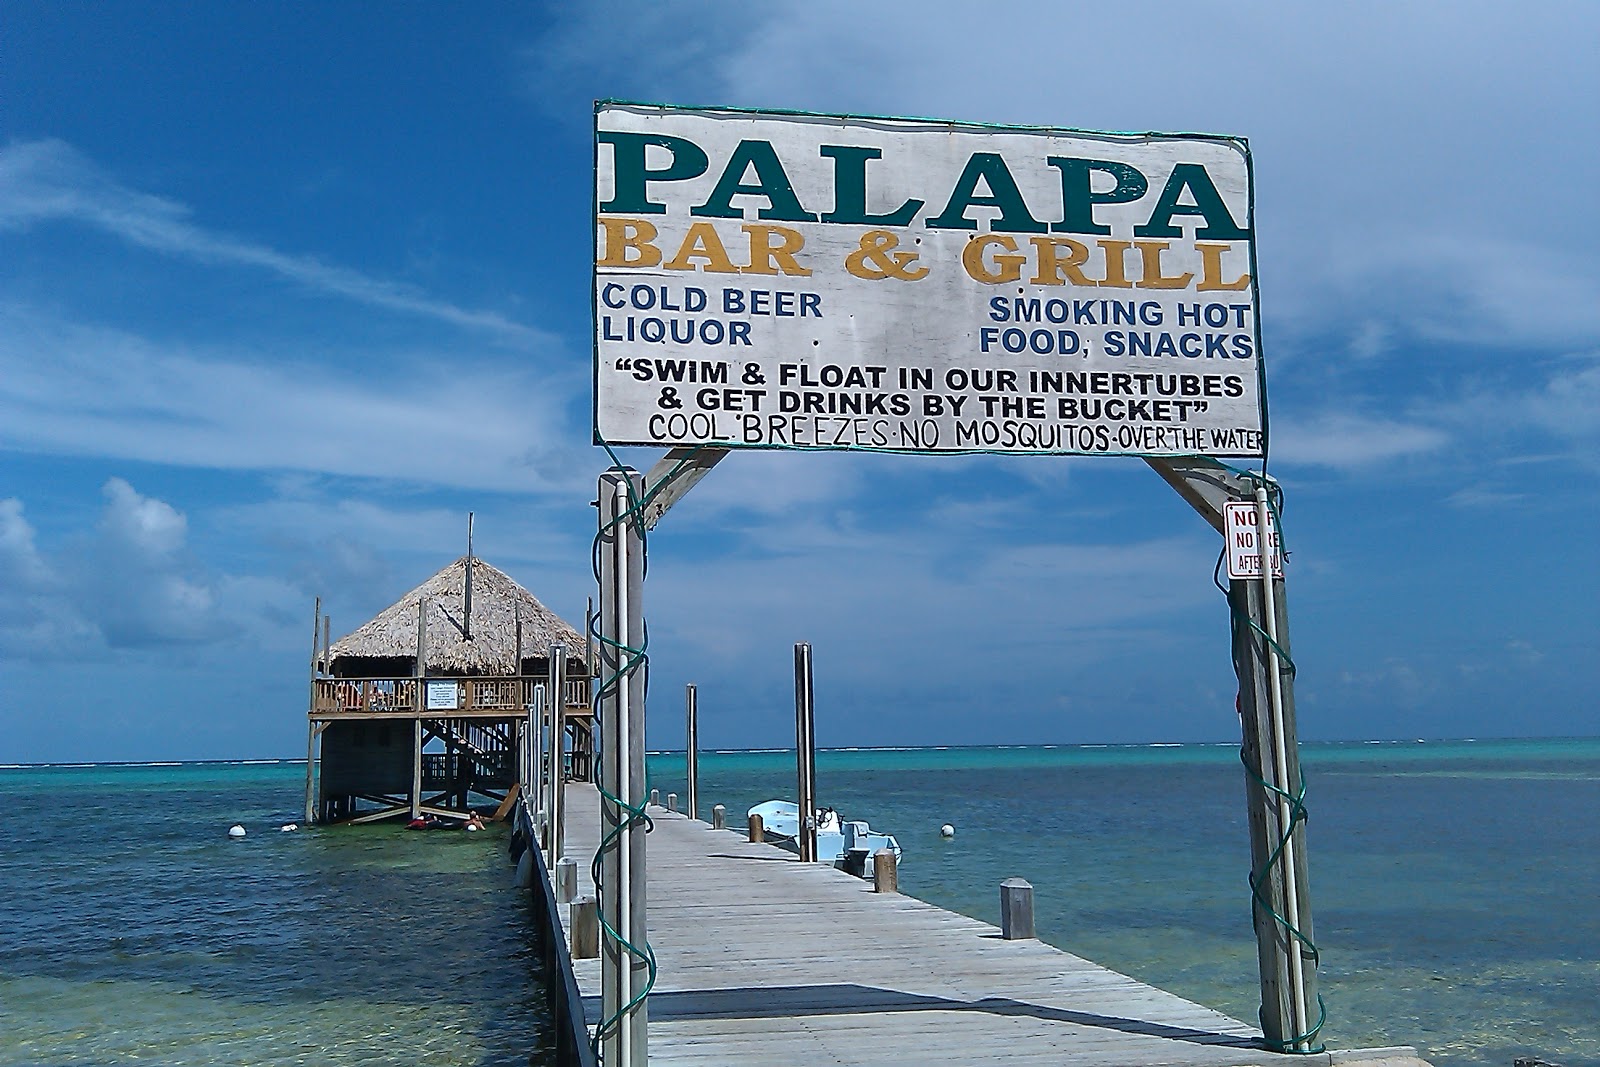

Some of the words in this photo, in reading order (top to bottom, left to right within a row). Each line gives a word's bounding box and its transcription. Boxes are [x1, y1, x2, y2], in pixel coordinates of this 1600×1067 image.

[597, 131, 1250, 240] PALAPA
[597, 217, 813, 278] BAR
[845, 230, 929, 281] &
[962, 234, 1250, 292] GRILL
[602, 283, 707, 313] COLD
[722, 288, 823, 318] BEER
[989, 296, 1163, 326] SMOKING
[1178, 303, 1251, 329] HOT
[602, 316, 752, 346] LIQUOR
[980, 328, 1089, 358] FOOD,
[1104, 331, 1253, 360] SNACKS
[741, 362, 767, 386] &
[780, 364, 886, 390] FLOAT
[899, 368, 933, 391] IN
[945, 369, 1018, 393] OUR
[1030, 371, 1243, 398] INNERTUBES
[658, 386, 684, 410] &
[696, 388, 767, 412] GET
[779, 391, 911, 416] DRINKS
[923, 395, 967, 417] BY
[979, 397, 1046, 420] THE
[900, 419, 939, 448] NO
[1172, 427, 1208, 450] THE
[1234, 511, 1258, 526] NO
[1236, 532, 1253, 548] NO
